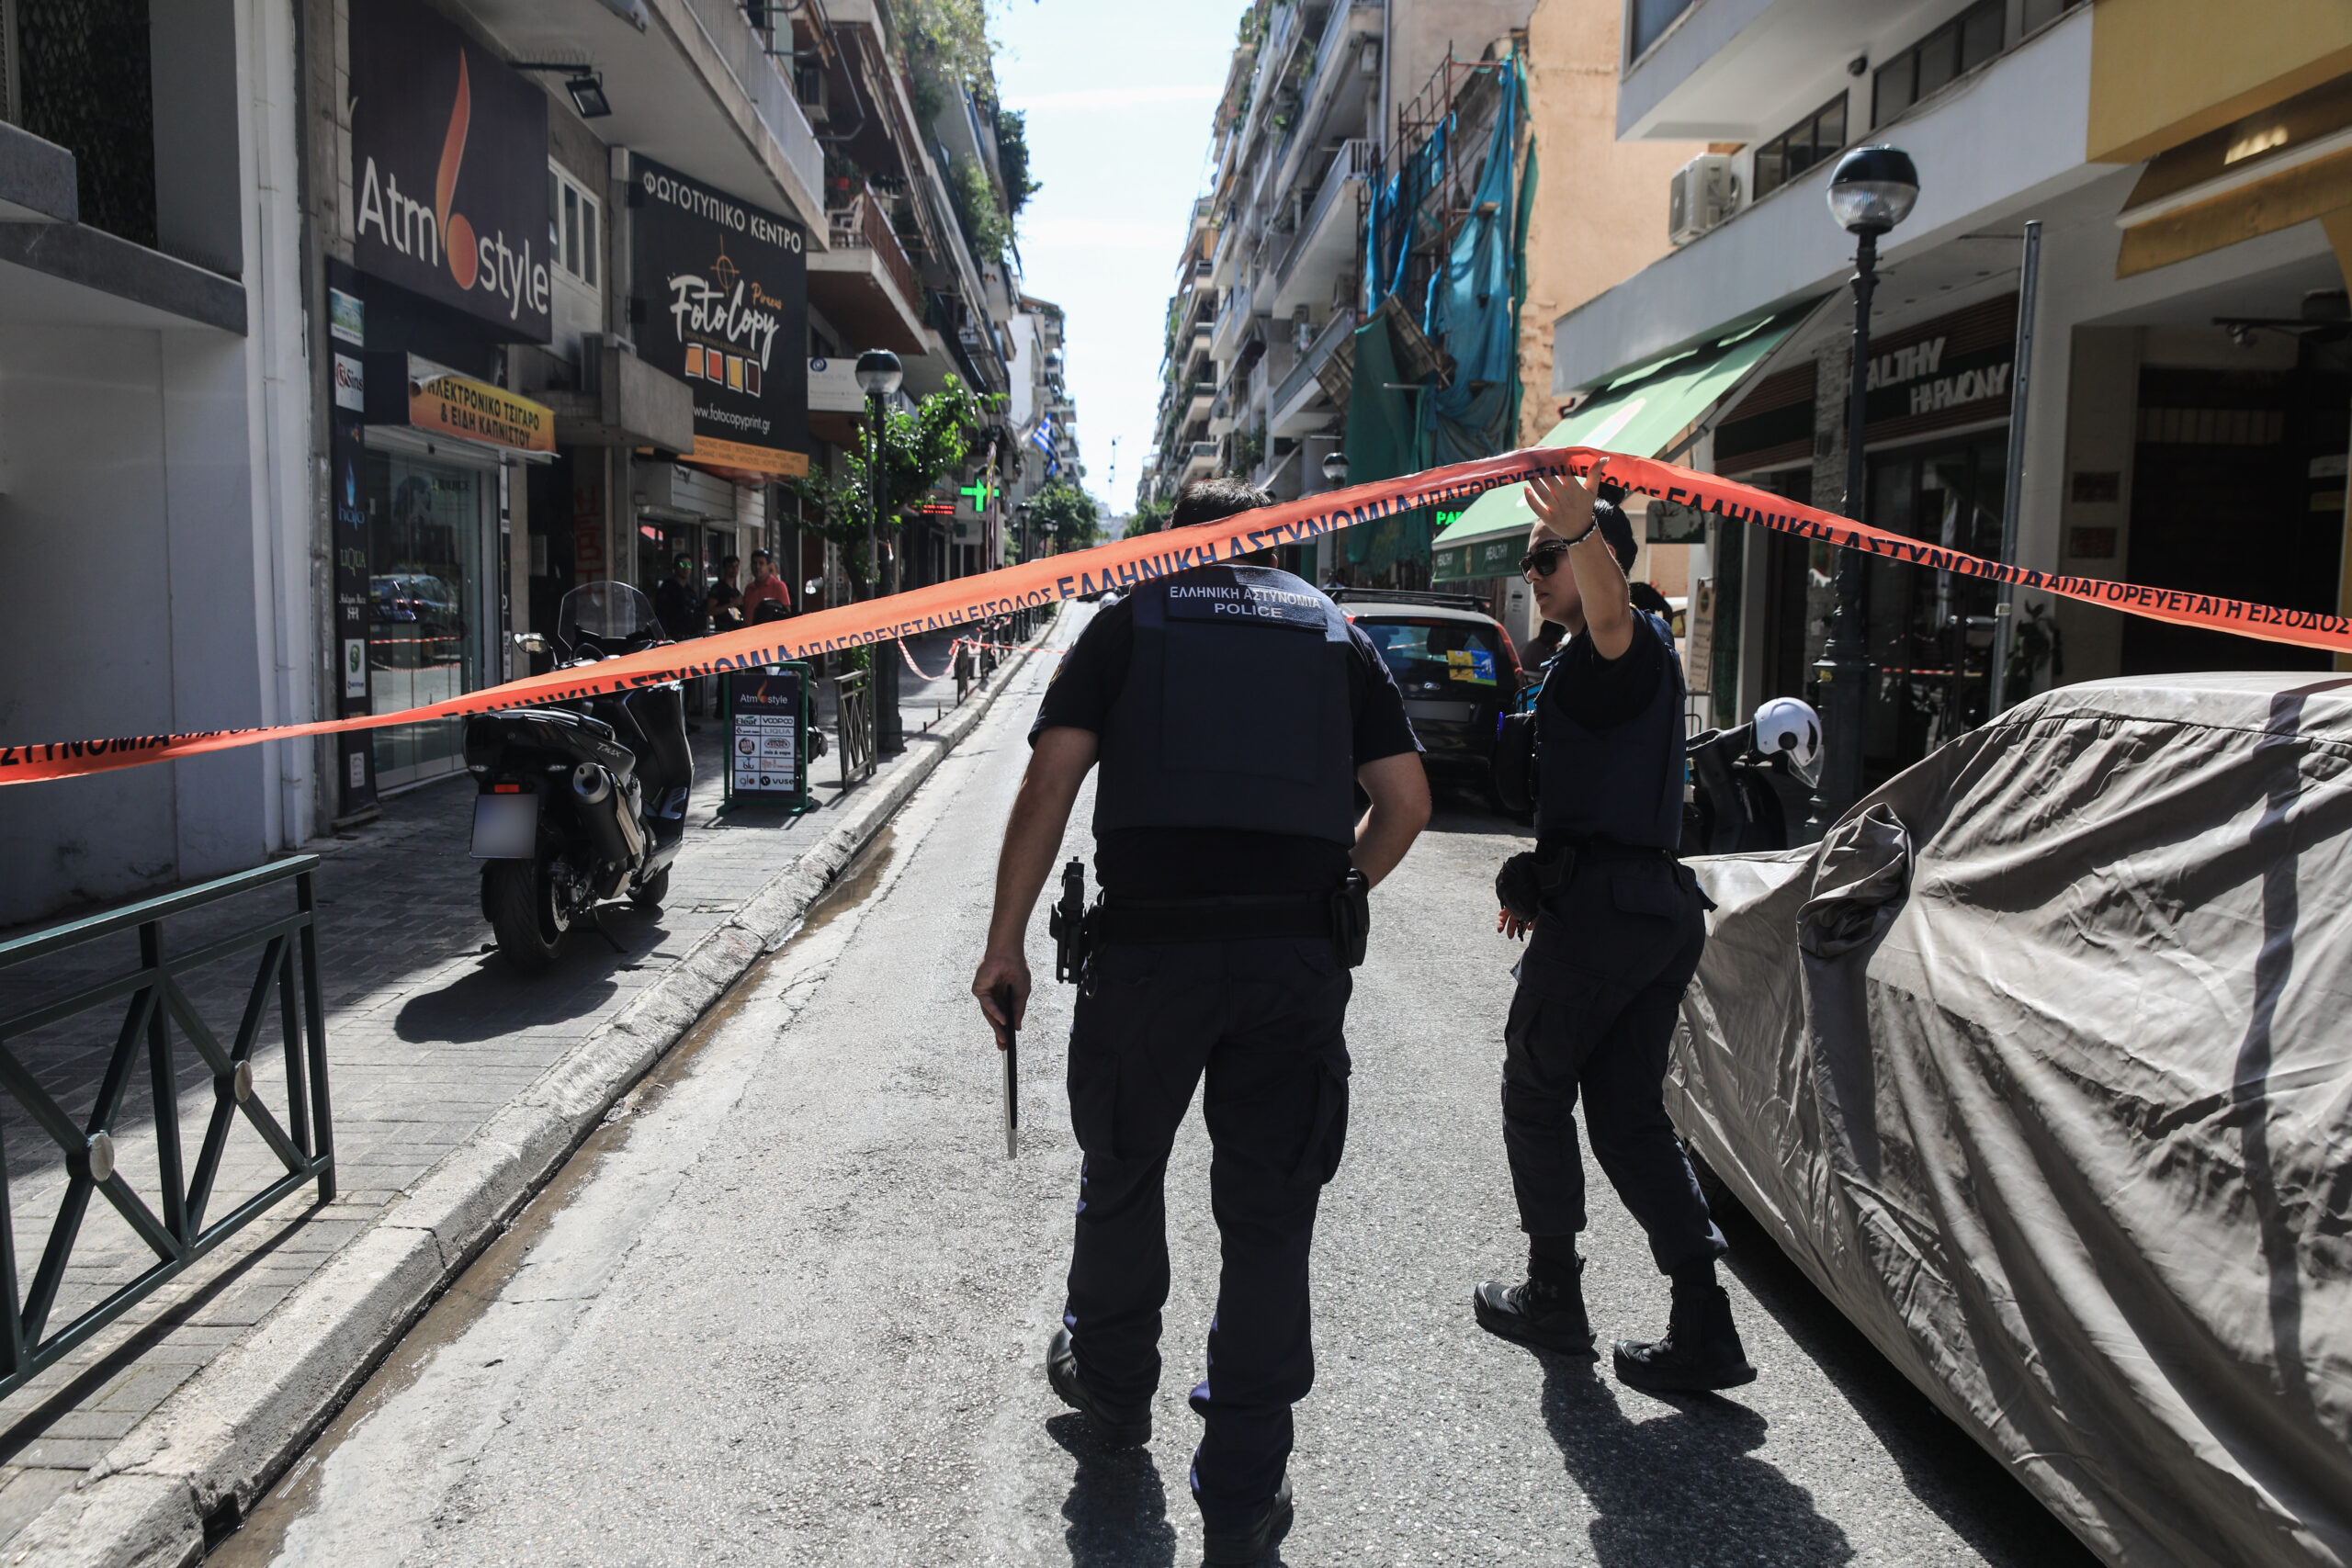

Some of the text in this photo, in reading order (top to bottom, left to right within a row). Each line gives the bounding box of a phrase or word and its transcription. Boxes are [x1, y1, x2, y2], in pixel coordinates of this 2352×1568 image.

[643, 171, 801, 254] ΦΩΤΟΤΥΠΙΚΟ ΚΕΝΤΡΟ
[1843, 336, 1947, 397] HALTHY
[427, 378, 540, 431] ΗΛΕΚΤΡΟΝΙΚΟ ΤΣΙΓΑΡΟ
[440, 403, 531, 449] & ΕΙΔΗ ΚΑΠΝΙΣΤΟΥ
[1057, 542, 1218, 600] ΕΛΛΗΝΙΚΗ
[1230, 494, 1412, 558] ΑΣΤΥΝΟΜΙΑ
[1844, 531, 2043, 589] ΑΣΤΥΝΟΜΙΑ
[2045, 576, 2221, 617] ΑΠΑΓΟΡΕΥΕΤΑΙ
[2225, 601, 2243, 620] Η
[2251, 604, 2350, 636] ΕΙΣΟΔΟΣ
[1170, 585, 1322, 610] ΕΛΛΗΝΙΚΗ ΑΣΤΥΝΟΜΙΑ
[1214, 603, 1283, 619] POLICE
[736, 717, 758, 726] Eleaf
[742, 761, 754, 770] blu
